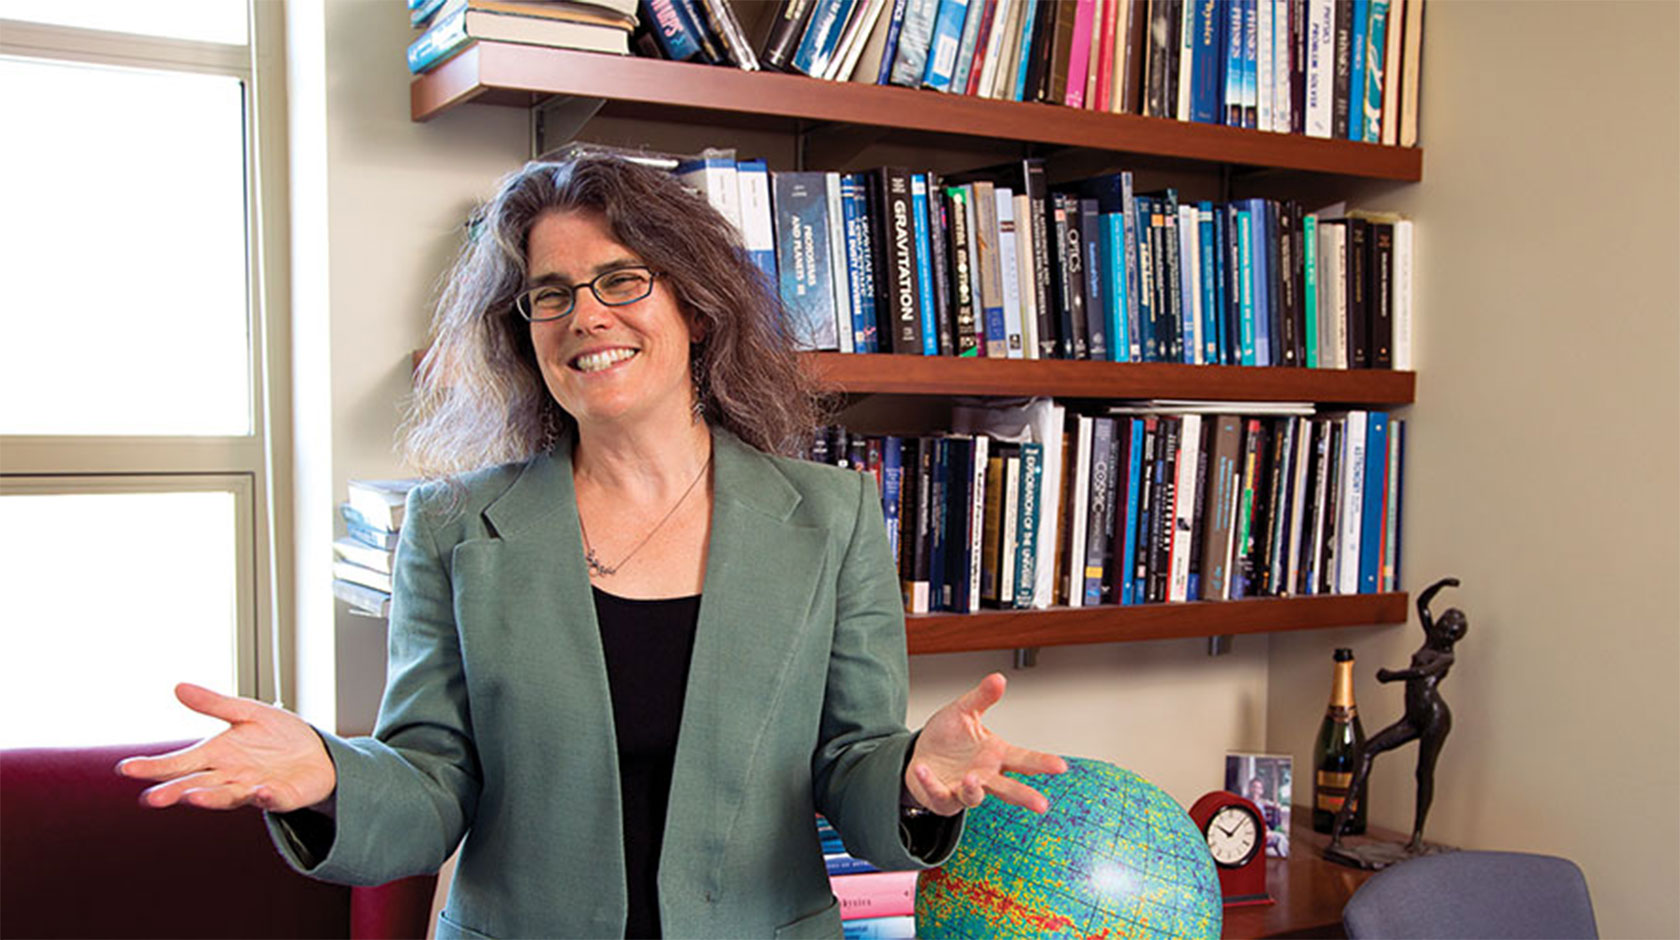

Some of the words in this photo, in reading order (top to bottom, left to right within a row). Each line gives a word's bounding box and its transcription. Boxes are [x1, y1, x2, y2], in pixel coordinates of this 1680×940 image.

[791, 215, 802, 240] AND
[1067, 228, 1082, 273] OPTICS
[793, 239, 806, 282] PLANETS
[893, 199, 914, 321] GRAVITATION
[957, 249, 971, 304] MOTION
[1023, 455, 1036, 516] EXPLORATION
[1092, 460, 1108, 513] COSMIC
[1352, 446, 1364, 494] ASTRONOMY
[1022, 531, 1032, 547] THE
[1023, 516, 1033, 530] OF
[1162, 482, 1175, 553] ASTRONOMY
[1020, 548, 1032, 590] UNIVERSE
